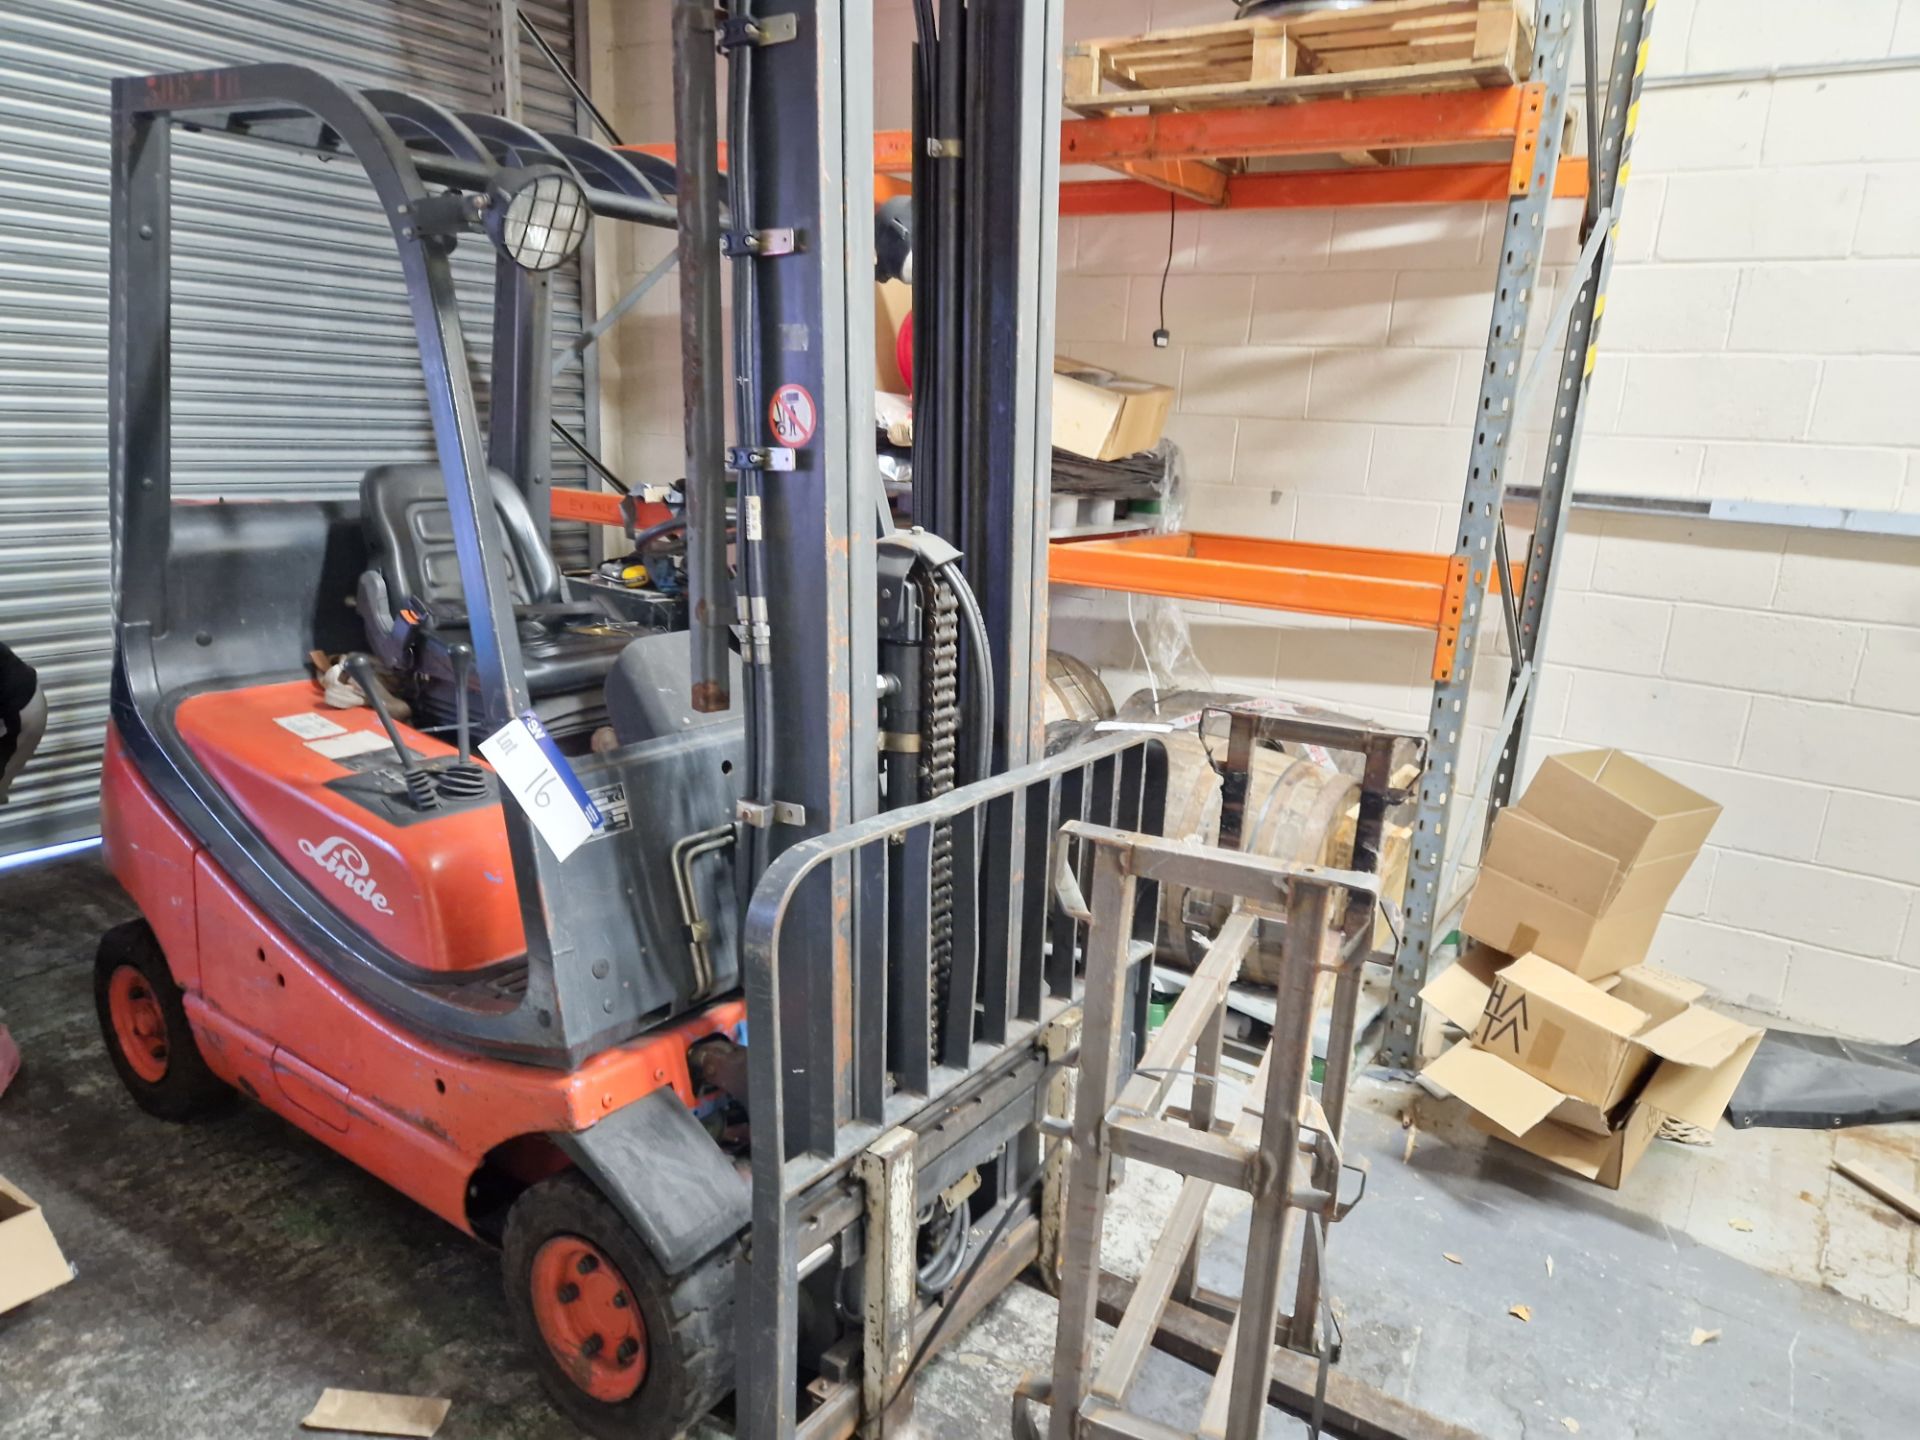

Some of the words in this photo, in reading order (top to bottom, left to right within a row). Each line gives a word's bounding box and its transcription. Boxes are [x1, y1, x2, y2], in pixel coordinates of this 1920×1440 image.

[495, 730, 519, 756] Lot
[524, 768, 557, 808] 16
[297, 835, 395, 916] Linde
